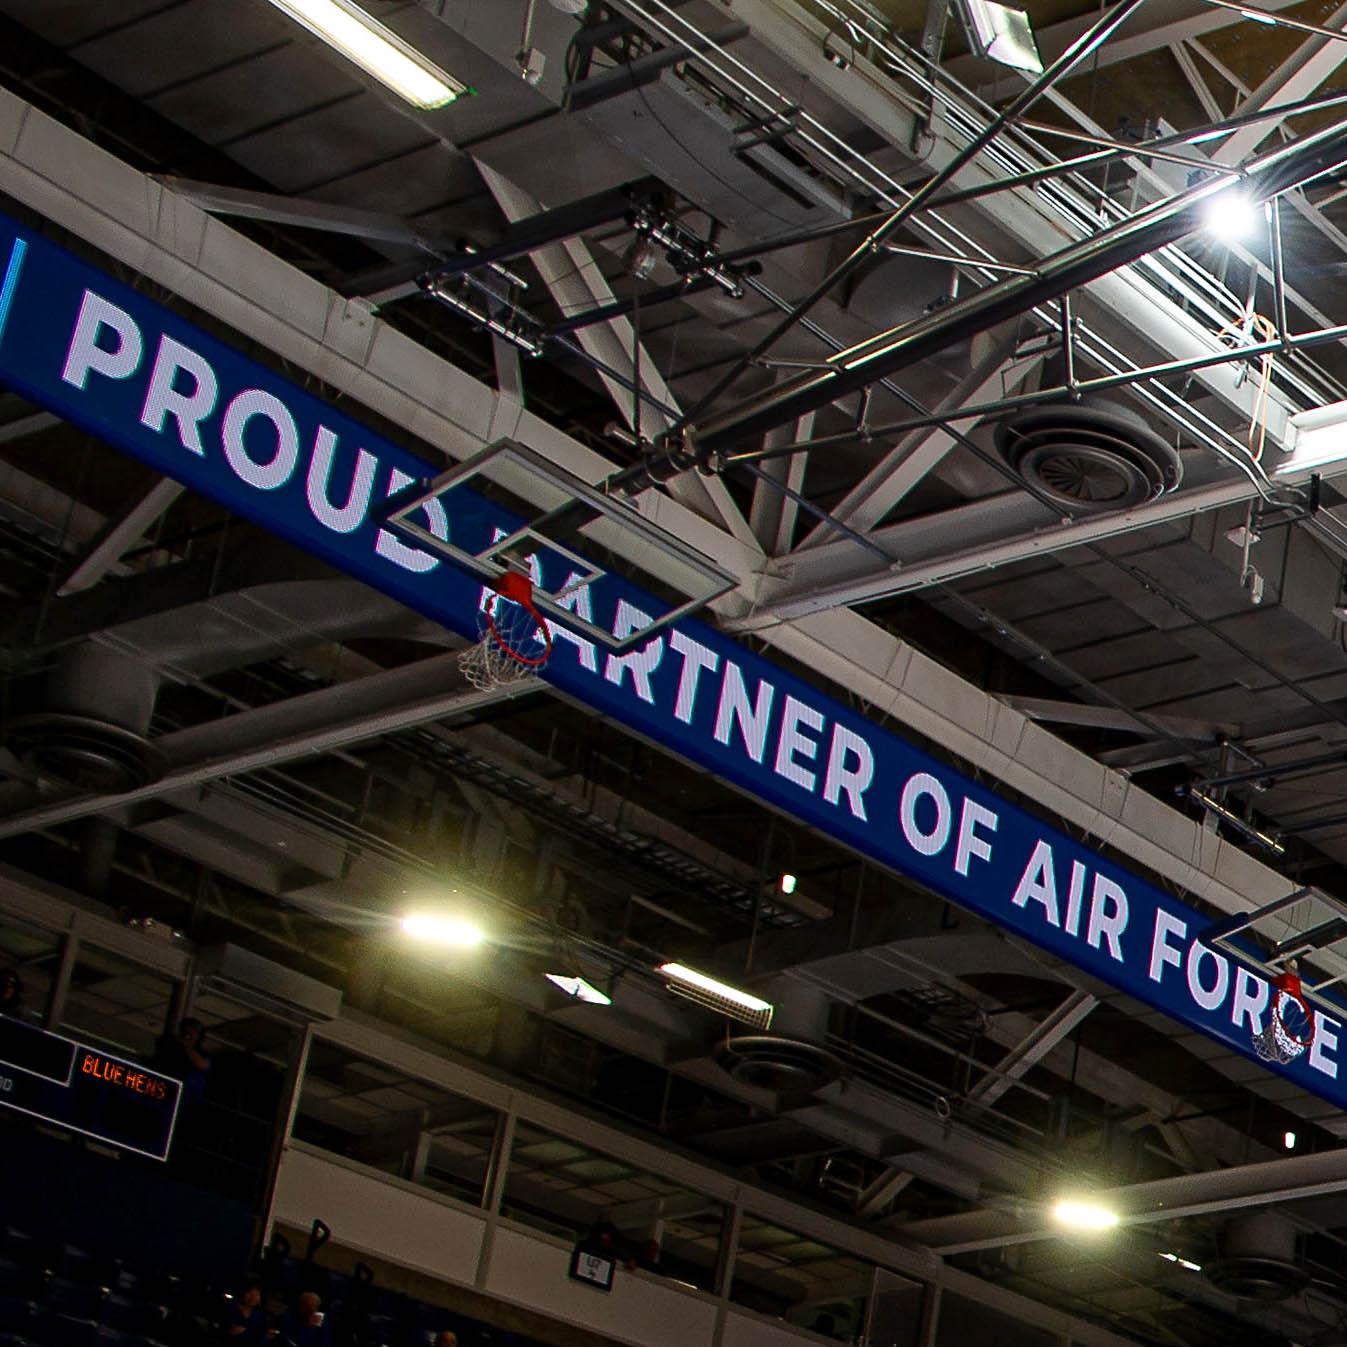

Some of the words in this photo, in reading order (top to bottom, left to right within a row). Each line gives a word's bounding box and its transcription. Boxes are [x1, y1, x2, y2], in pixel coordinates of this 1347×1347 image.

[62, 289, 450, 573] PROUD
[900, 772, 999, 877] OF
[1011, 840, 1129, 963] AIR
[82, 1055, 125, 1085] BLUE
[126, 1069, 166, 1100] HENS
